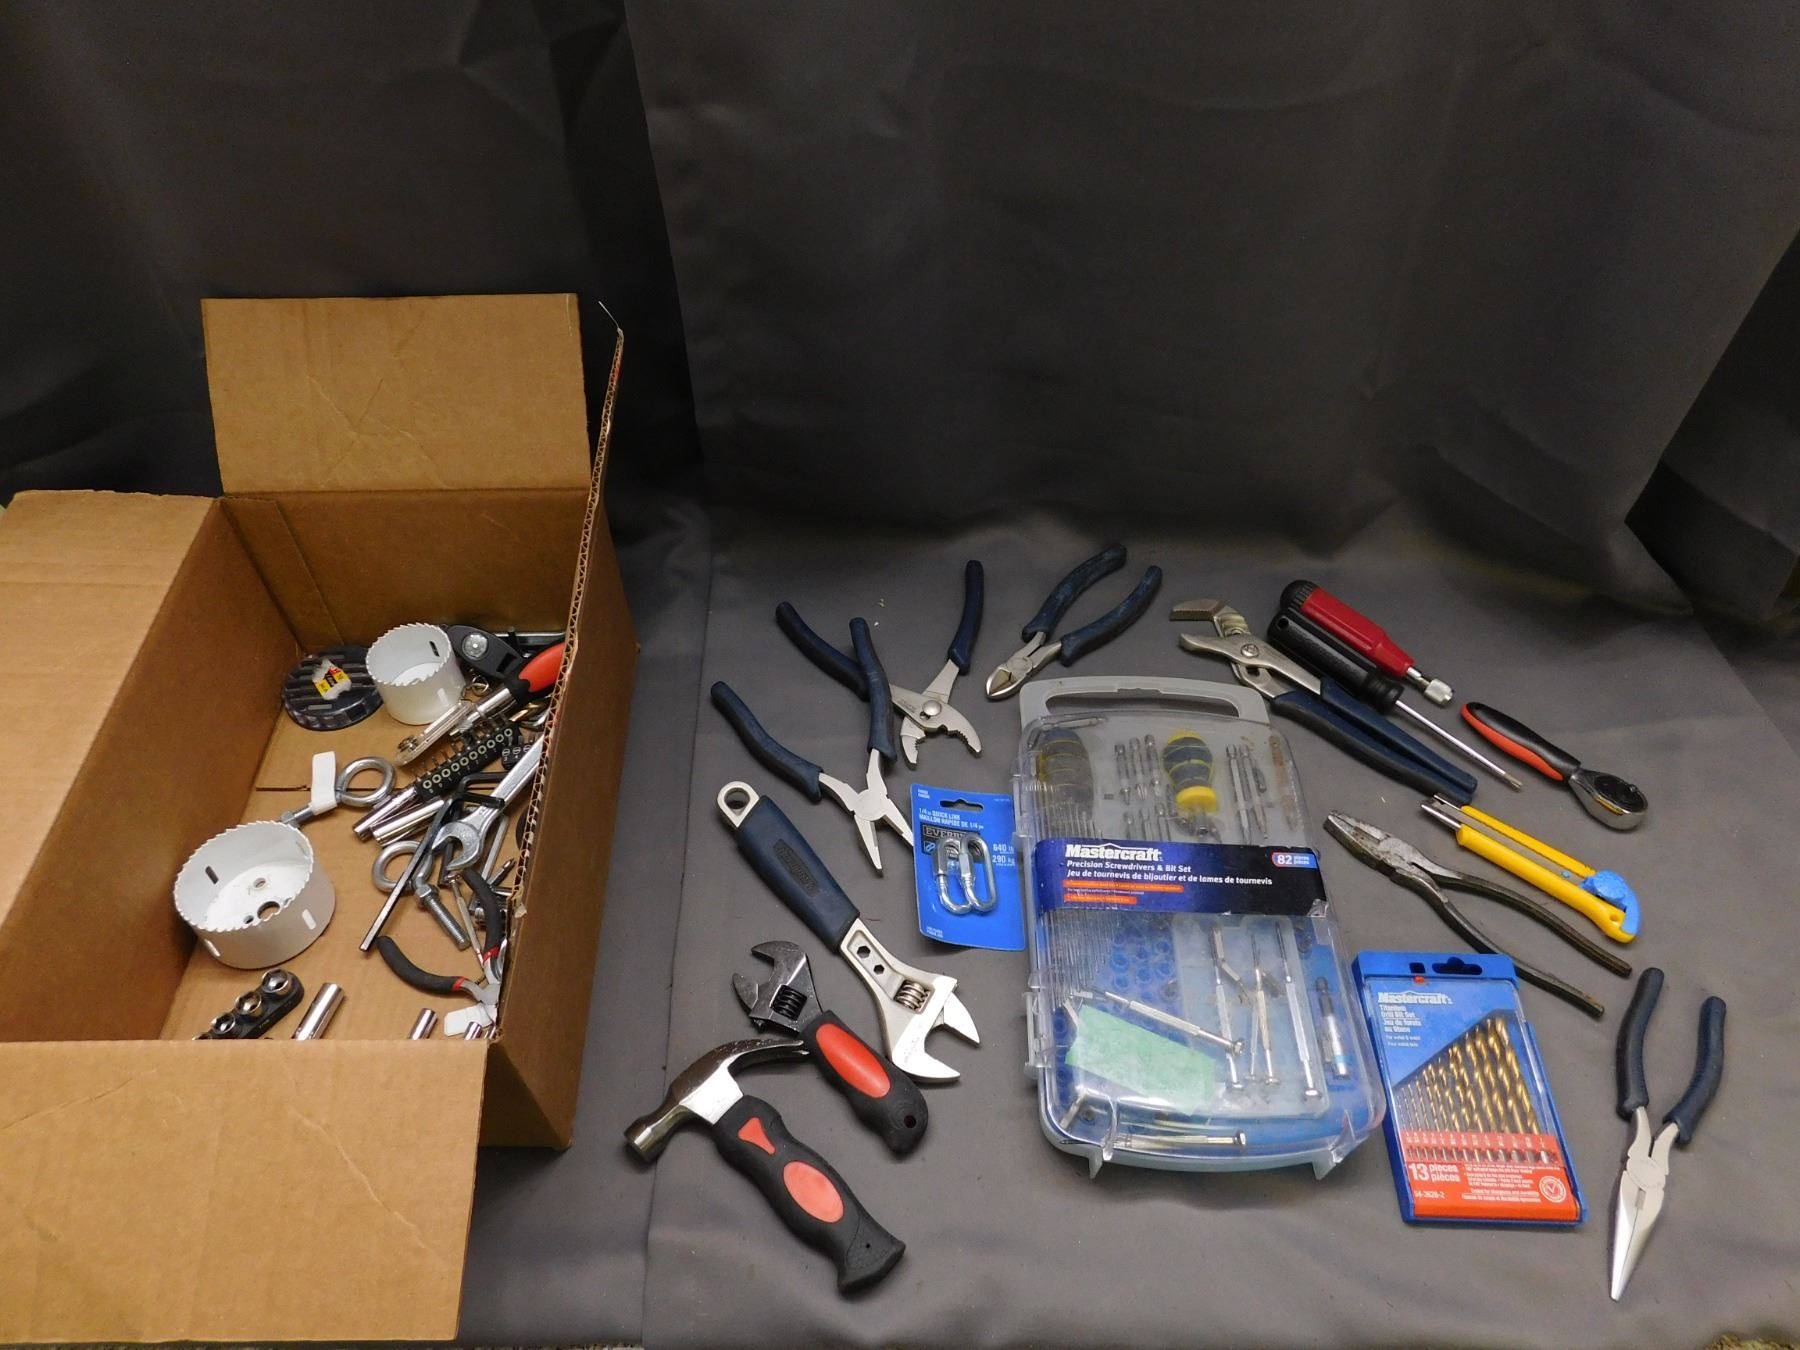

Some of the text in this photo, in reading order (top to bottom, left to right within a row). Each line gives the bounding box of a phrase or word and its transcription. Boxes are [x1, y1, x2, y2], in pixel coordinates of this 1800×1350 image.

[932, 810, 948, 818] QUICK
[992, 843, 1007, 852] 640
[1065, 843, 1162, 861] Mastercraft
[1277, 854, 1293, 865] 82
[1067, 860, 1103, 869] Precision
[1105, 862, 1155, 871] Screwdrivers
[1165, 864, 1177, 872] Bit
[1178, 865, 1192, 873] Set
[1067, 869, 1080, 877] Jeu
[1093, 871, 1130, 879] tournevis
[1132, 872, 1142, 880] de
[1144, 872, 1177, 882] bijoutier
[1199, 874, 1223, 883] lames
[1224, 876, 1235, 884] de
[1236, 876, 1273, 885] tournevis
[1377, 991, 1450, 1005] Mastercraft
[1408, 1163, 1430, 1181] 13
[1429, 1162, 1459, 1173] pieces
